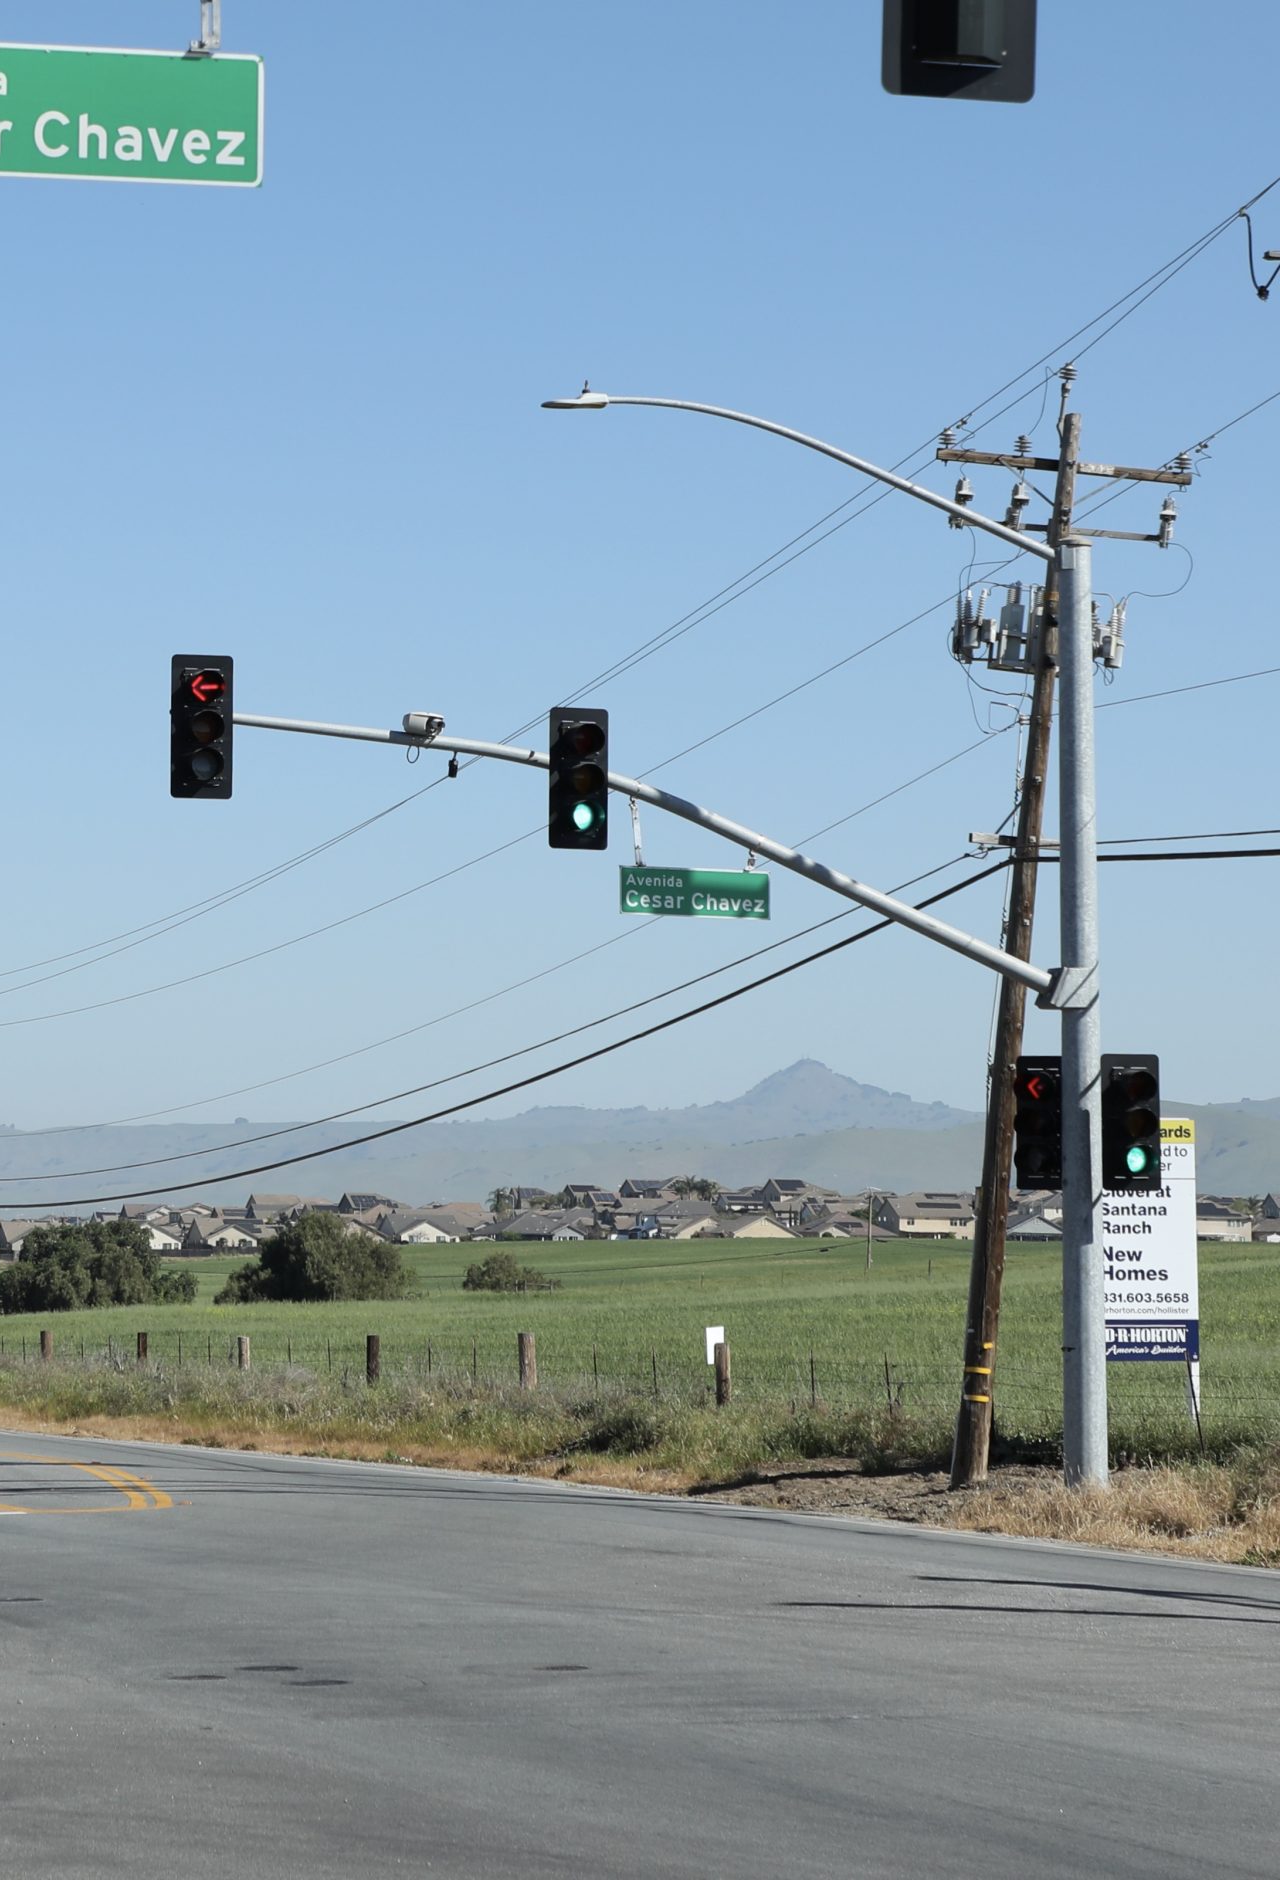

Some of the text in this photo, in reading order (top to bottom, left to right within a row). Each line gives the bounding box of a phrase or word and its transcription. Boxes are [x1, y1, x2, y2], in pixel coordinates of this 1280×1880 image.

[34, 110, 246, 166] Chavez
[626, 874, 683, 888] Avenida
[625, 890, 765, 913] Cesar Chavez
[1174, 1146, 1188, 1157] to
[1155, 1185, 1172, 1198] at
[1102, 1202, 1167, 1216] Santana
[1102, 1220, 1152, 1234] Ranch
[1103, 1246, 1142, 1262] New
[1103, 1265, 1169, 1281] Homes
[1104, 1306, 1189, 1315] rhorton.com/hollister
